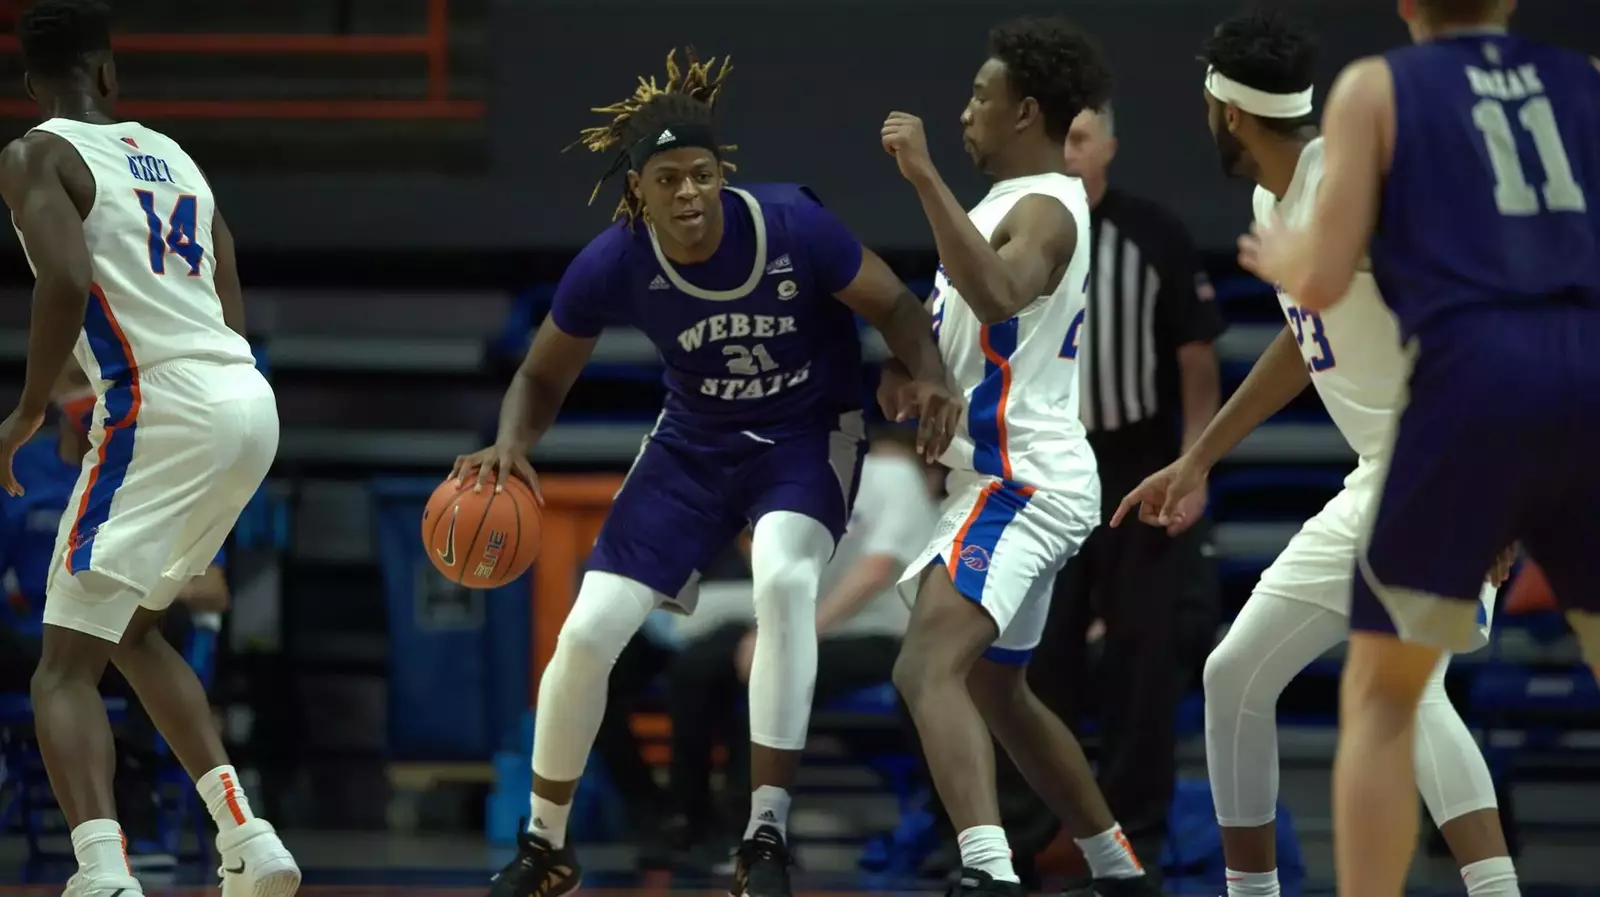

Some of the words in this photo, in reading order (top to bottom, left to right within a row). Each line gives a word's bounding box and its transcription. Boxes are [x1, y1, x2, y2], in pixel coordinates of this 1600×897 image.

[1471, 95, 1587, 216] 11
[133, 188, 204, 276] 14
[677, 312, 798, 353] WEBER
[721, 343, 780, 376] 21
